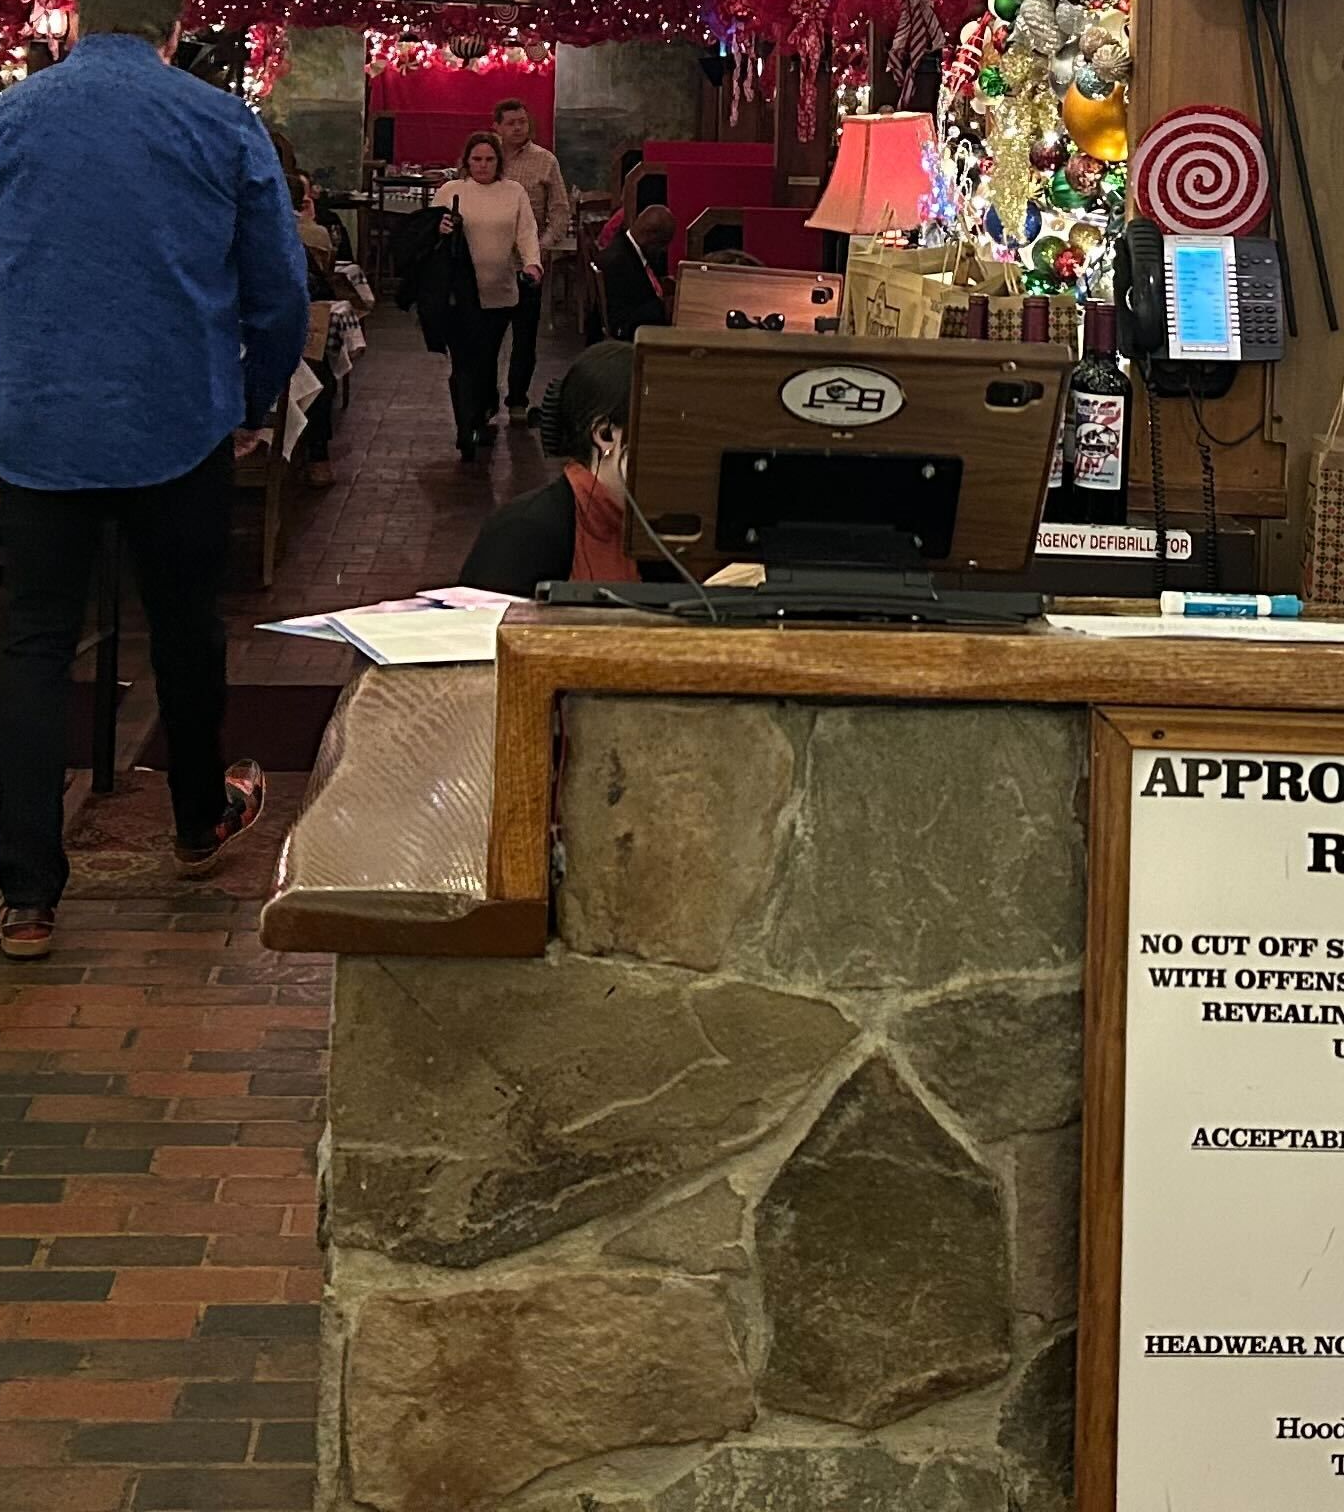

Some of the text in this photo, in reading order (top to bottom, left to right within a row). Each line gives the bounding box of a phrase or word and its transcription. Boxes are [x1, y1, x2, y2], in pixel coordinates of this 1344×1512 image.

[1036, 533, 1188, 554] RGENCY DEFIBRILLTOR
[1141, 935, 1182, 954] NO
[1192, 935, 1250, 955] CUT
[1259, 937, 1318, 957] OFF
[1149, 968, 1226, 988] WITH
[1144, 1334, 1306, 1355] HEADWEAR
